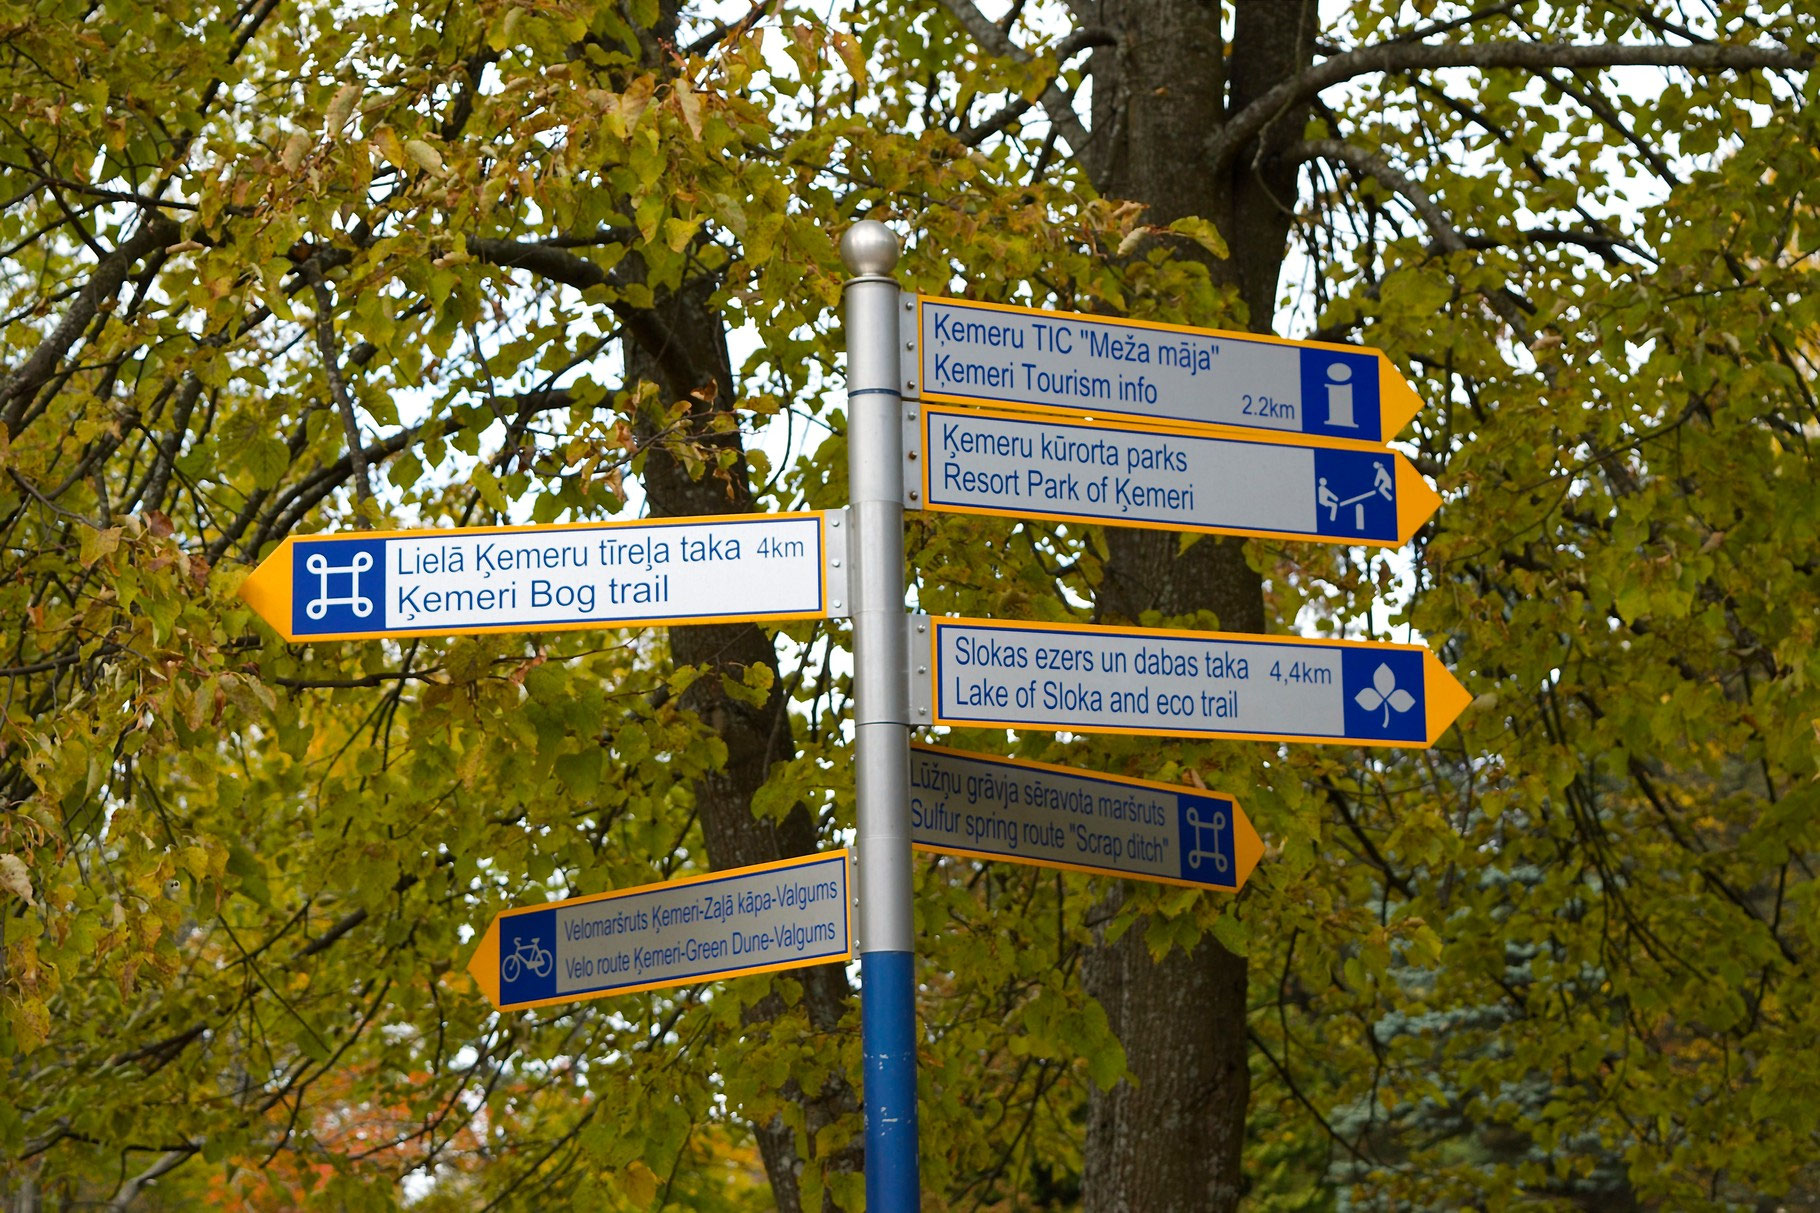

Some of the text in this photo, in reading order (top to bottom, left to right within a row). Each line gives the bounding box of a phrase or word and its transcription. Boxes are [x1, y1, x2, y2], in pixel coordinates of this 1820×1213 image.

[935, 313, 1219, 376] Ķemeru TIC "Meža māja"
[935, 354, 1157, 404] Ķemeri Tourism info
[1242, 394, 1296, 420] 2.2km
[944, 423, 1188, 476] Ķemeru kūrorta parks
[944, 463, 1194, 513] Resort Park of Ķemeri
[398, 533, 805, 579] Lielā Ķemeru tīreļa taka 4km
[398, 574, 669, 622] Ķemeri Bog trail
[955, 637, 1332, 686] Slokas ezers un dabas taka 4,4km
[955, 678, 1238, 718] Lake of Sloka and eco trail
[967, 768, 1020, 810] grāvja
[1024, 780, 1094, 814] sēravota
[1099, 791, 1166, 826] maršruts
[910, 799, 1169, 863] Sulfur spring route "Scrap ditch"
[564, 911, 648, 942] Velomaršruts
[738, 878, 838, 915] kāpa-Valgums
[566, 920, 836, 979] Velo route Ķemeri-Green Dune-Valgums
